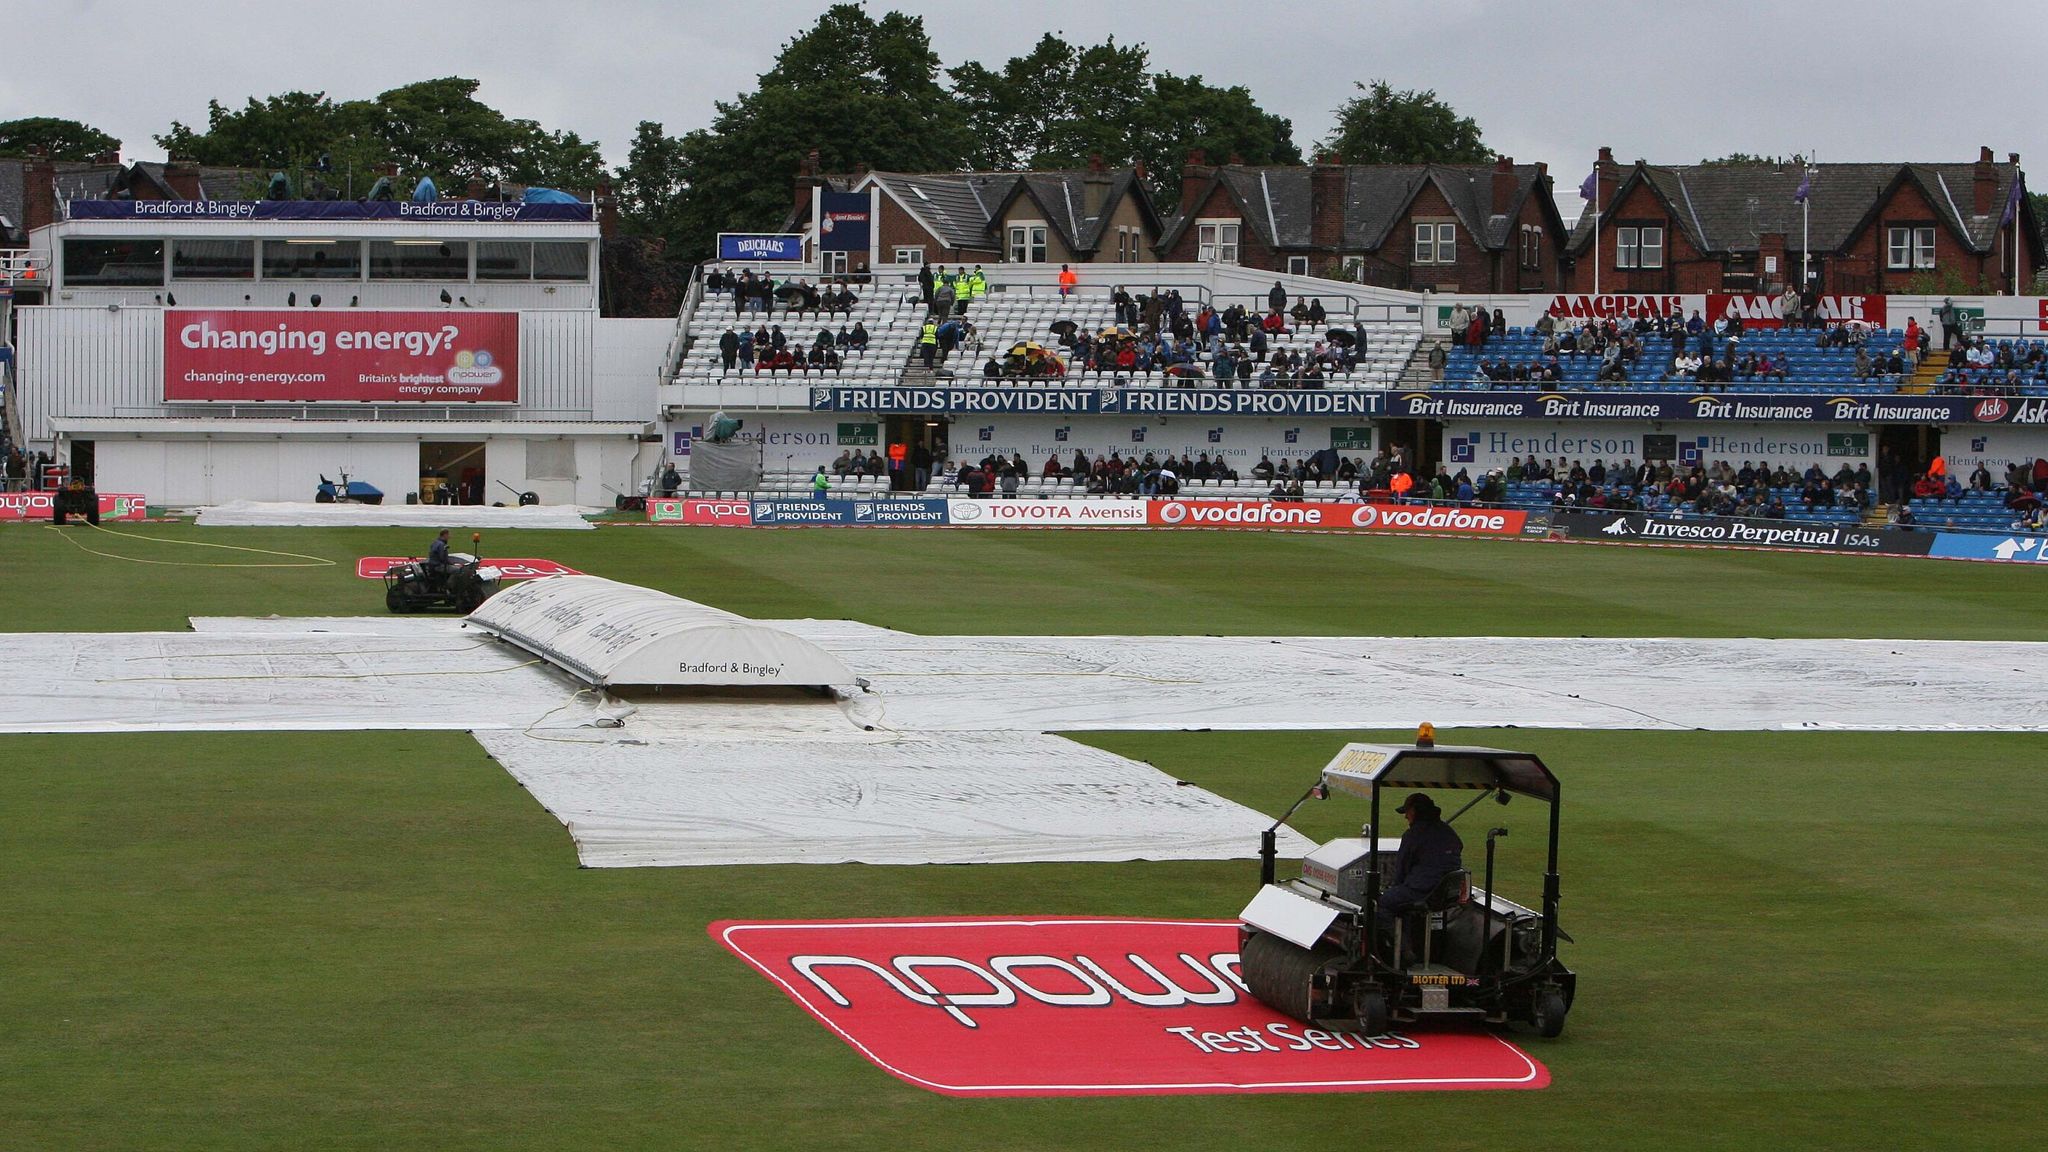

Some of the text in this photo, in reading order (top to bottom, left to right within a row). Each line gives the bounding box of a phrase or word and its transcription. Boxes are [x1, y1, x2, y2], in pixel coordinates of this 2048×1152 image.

[135, 201, 256, 217] Bradford & Bingley
[400, 202, 521, 219] Bradford & Bingley
[737, 239, 785, 253] DEUCHARS
[180, 321, 459, 356] Changing energy?
[184, 369, 326, 385] changing-energy.com
[358, 370, 497, 385] Britain's brightest npower
[399, 385, 484, 395] energy company
[839, 390, 1092, 411] FRIENDS PROVIDENT
[1126, 393, 1381, 413] FRIENDS PROVIDENT
[1409, 398, 1523, 416] Brit Insurance
[1544, 399, 1660, 417] Brit Insurance
[1977, 398, 2002, 417] Ask
[1696, 401, 1813, 419] Brit Insurance
[1834, 402, 1951, 420] Brit Insurance
[2011, 398, 2048, 424] Ask
[854, 426, 861, 436] P
[1347, 431, 1354, 440] P
[955, 444, 1018, 455] Henderson
[1031, 445, 1094, 455] Henderon
[1184, 446, 1247, 457] Henderson
[1261, 446, 1317, 457] Henderso
[1488, 432, 1636, 455] Henderson
[1711, 436, 1824, 455] Henderson
[776, 503, 826, 511] FRIENDS
[876, 503, 926, 511] FRIENDS
[989, 505, 1144, 519] TOYOTA Avensis
[1190, 503, 1322, 524] vodafone
[777, 512, 843, 520] PROVIDENT
[877, 512, 943, 520] PROVIDENT
[1382, 508, 1505, 530] vodafone
[1640, 518, 1881, 547] Invesco Perpetual ISAs
[679, 662, 781, 678] Bradford & Bingley
[1412, 975, 1466, 985] BLOTTER LTD
[789, 953, 1240, 1028] npow
[1165, 1025, 1281, 1053] Test
